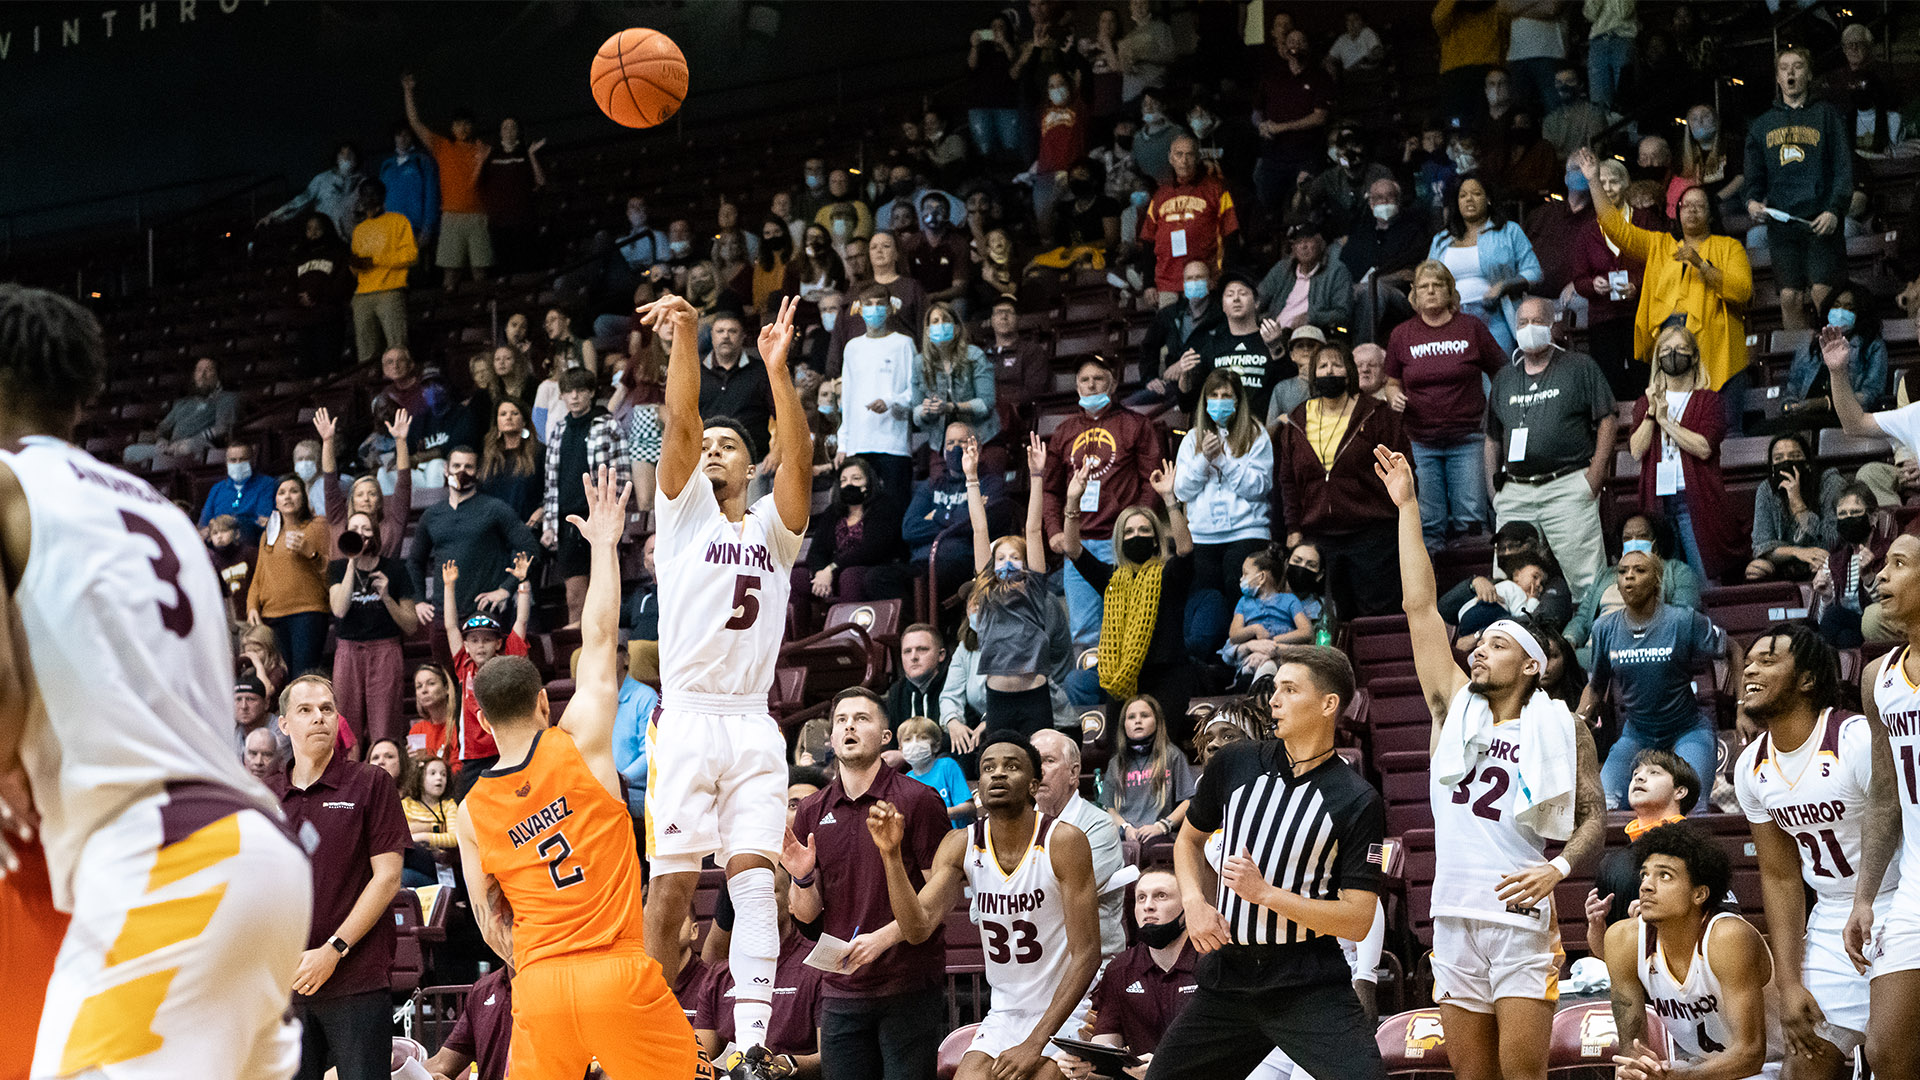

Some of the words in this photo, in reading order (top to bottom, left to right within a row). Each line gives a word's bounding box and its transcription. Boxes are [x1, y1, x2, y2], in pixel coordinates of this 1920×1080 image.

[0, 0, 270, 60] INTHRO
[1214, 354, 1267, 368] WINTHROP
[1409, 339, 1469, 358] WINTHROP
[117, 508, 194, 639] 3
[705, 541, 775, 573] WINTHRO
[725, 574, 762, 631] 5
[1618, 647, 1672, 659] WINTHROP
[1619, 656, 1671, 664] BASKETBALL
[1451, 765, 1510, 823] 32
[507, 796, 574, 850] ALVAREZ
[536, 830, 586, 891] 2
[1796, 829, 1855, 879] 21
[982, 918, 1043, 965] 33
[1653, 994, 1719, 1021] WINTHOP
